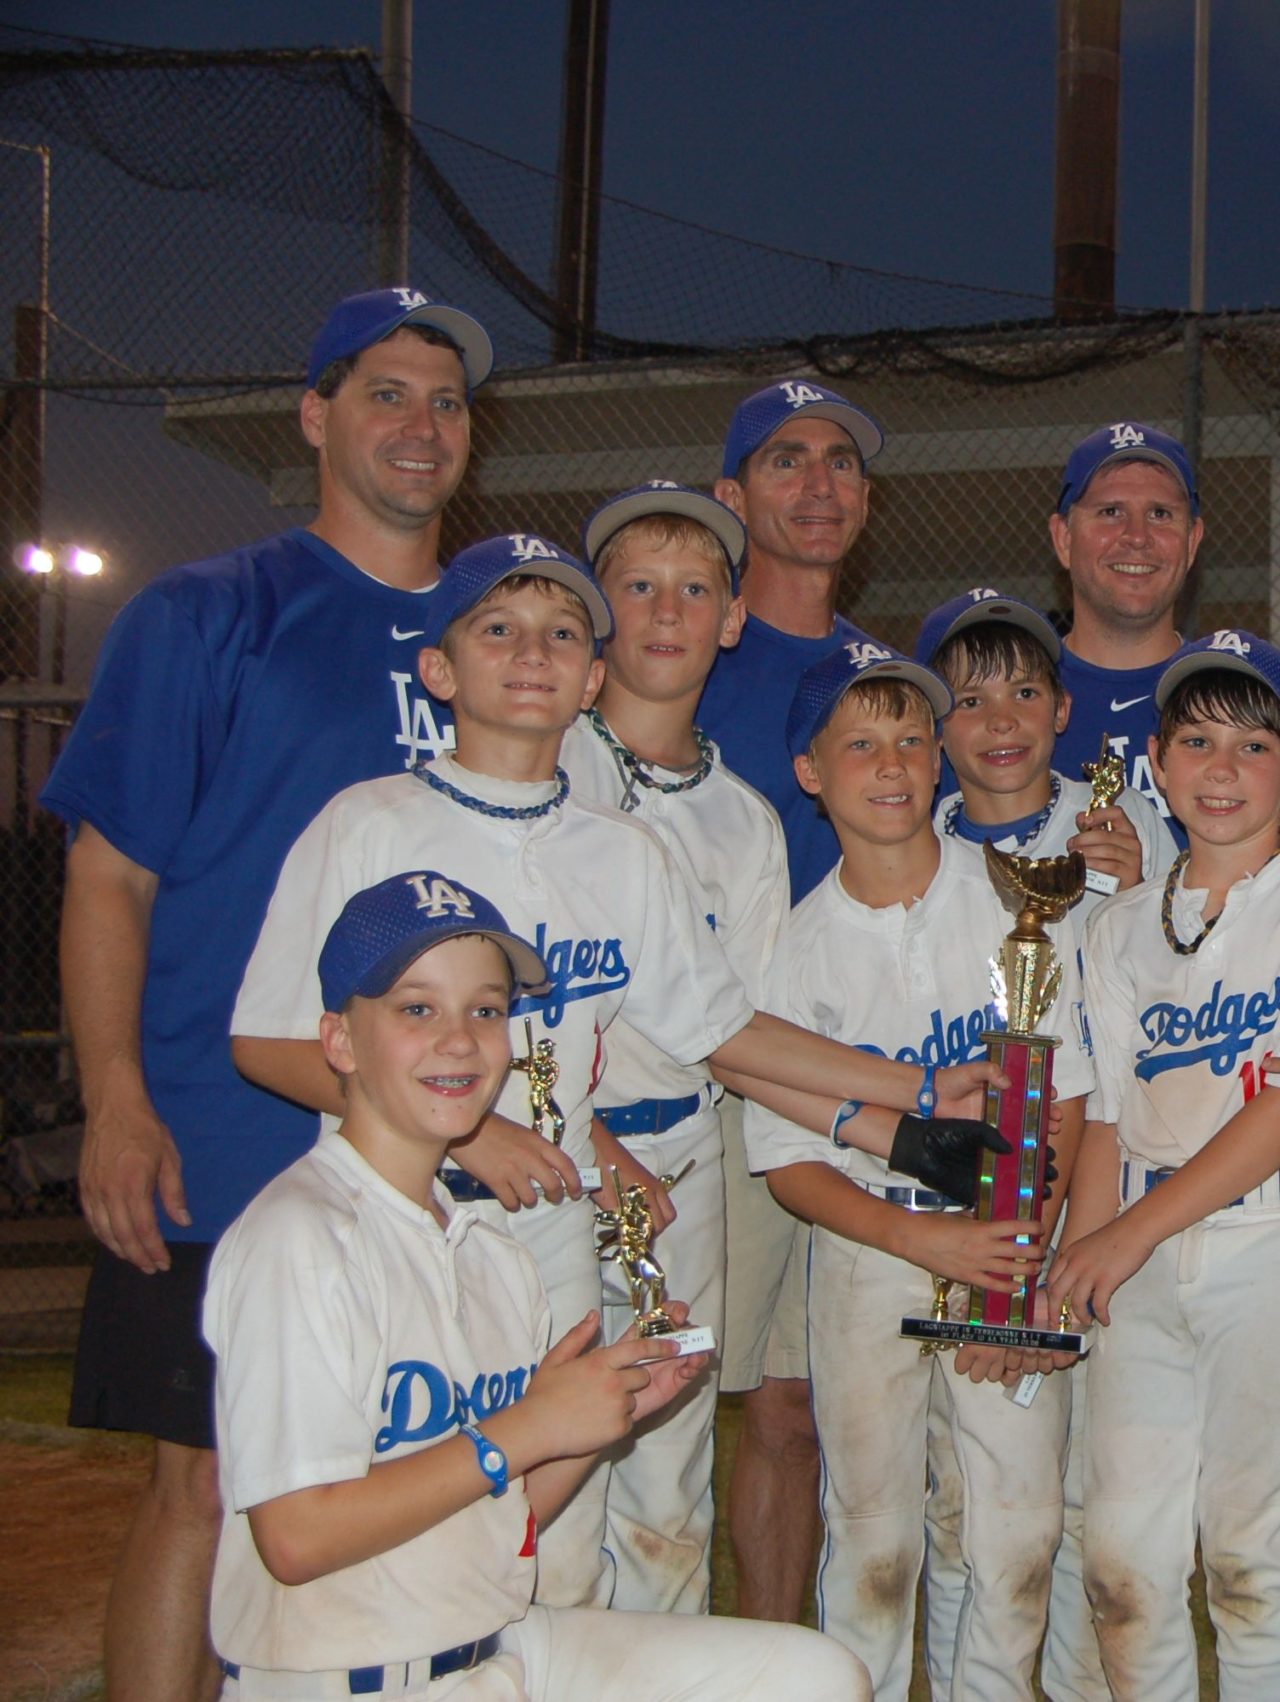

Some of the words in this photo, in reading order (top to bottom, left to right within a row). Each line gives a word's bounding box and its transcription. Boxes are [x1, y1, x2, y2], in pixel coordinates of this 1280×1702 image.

[779, 381, 824, 408] LA
[1110, 422, 1146, 449] LA
[508, 533, 559, 562] LA
[844, 642, 892, 669] LA
[1207, 629, 1251, 658] LA
[390, 671, 457, 770] LA
[406, 874, 476, 919] LA
